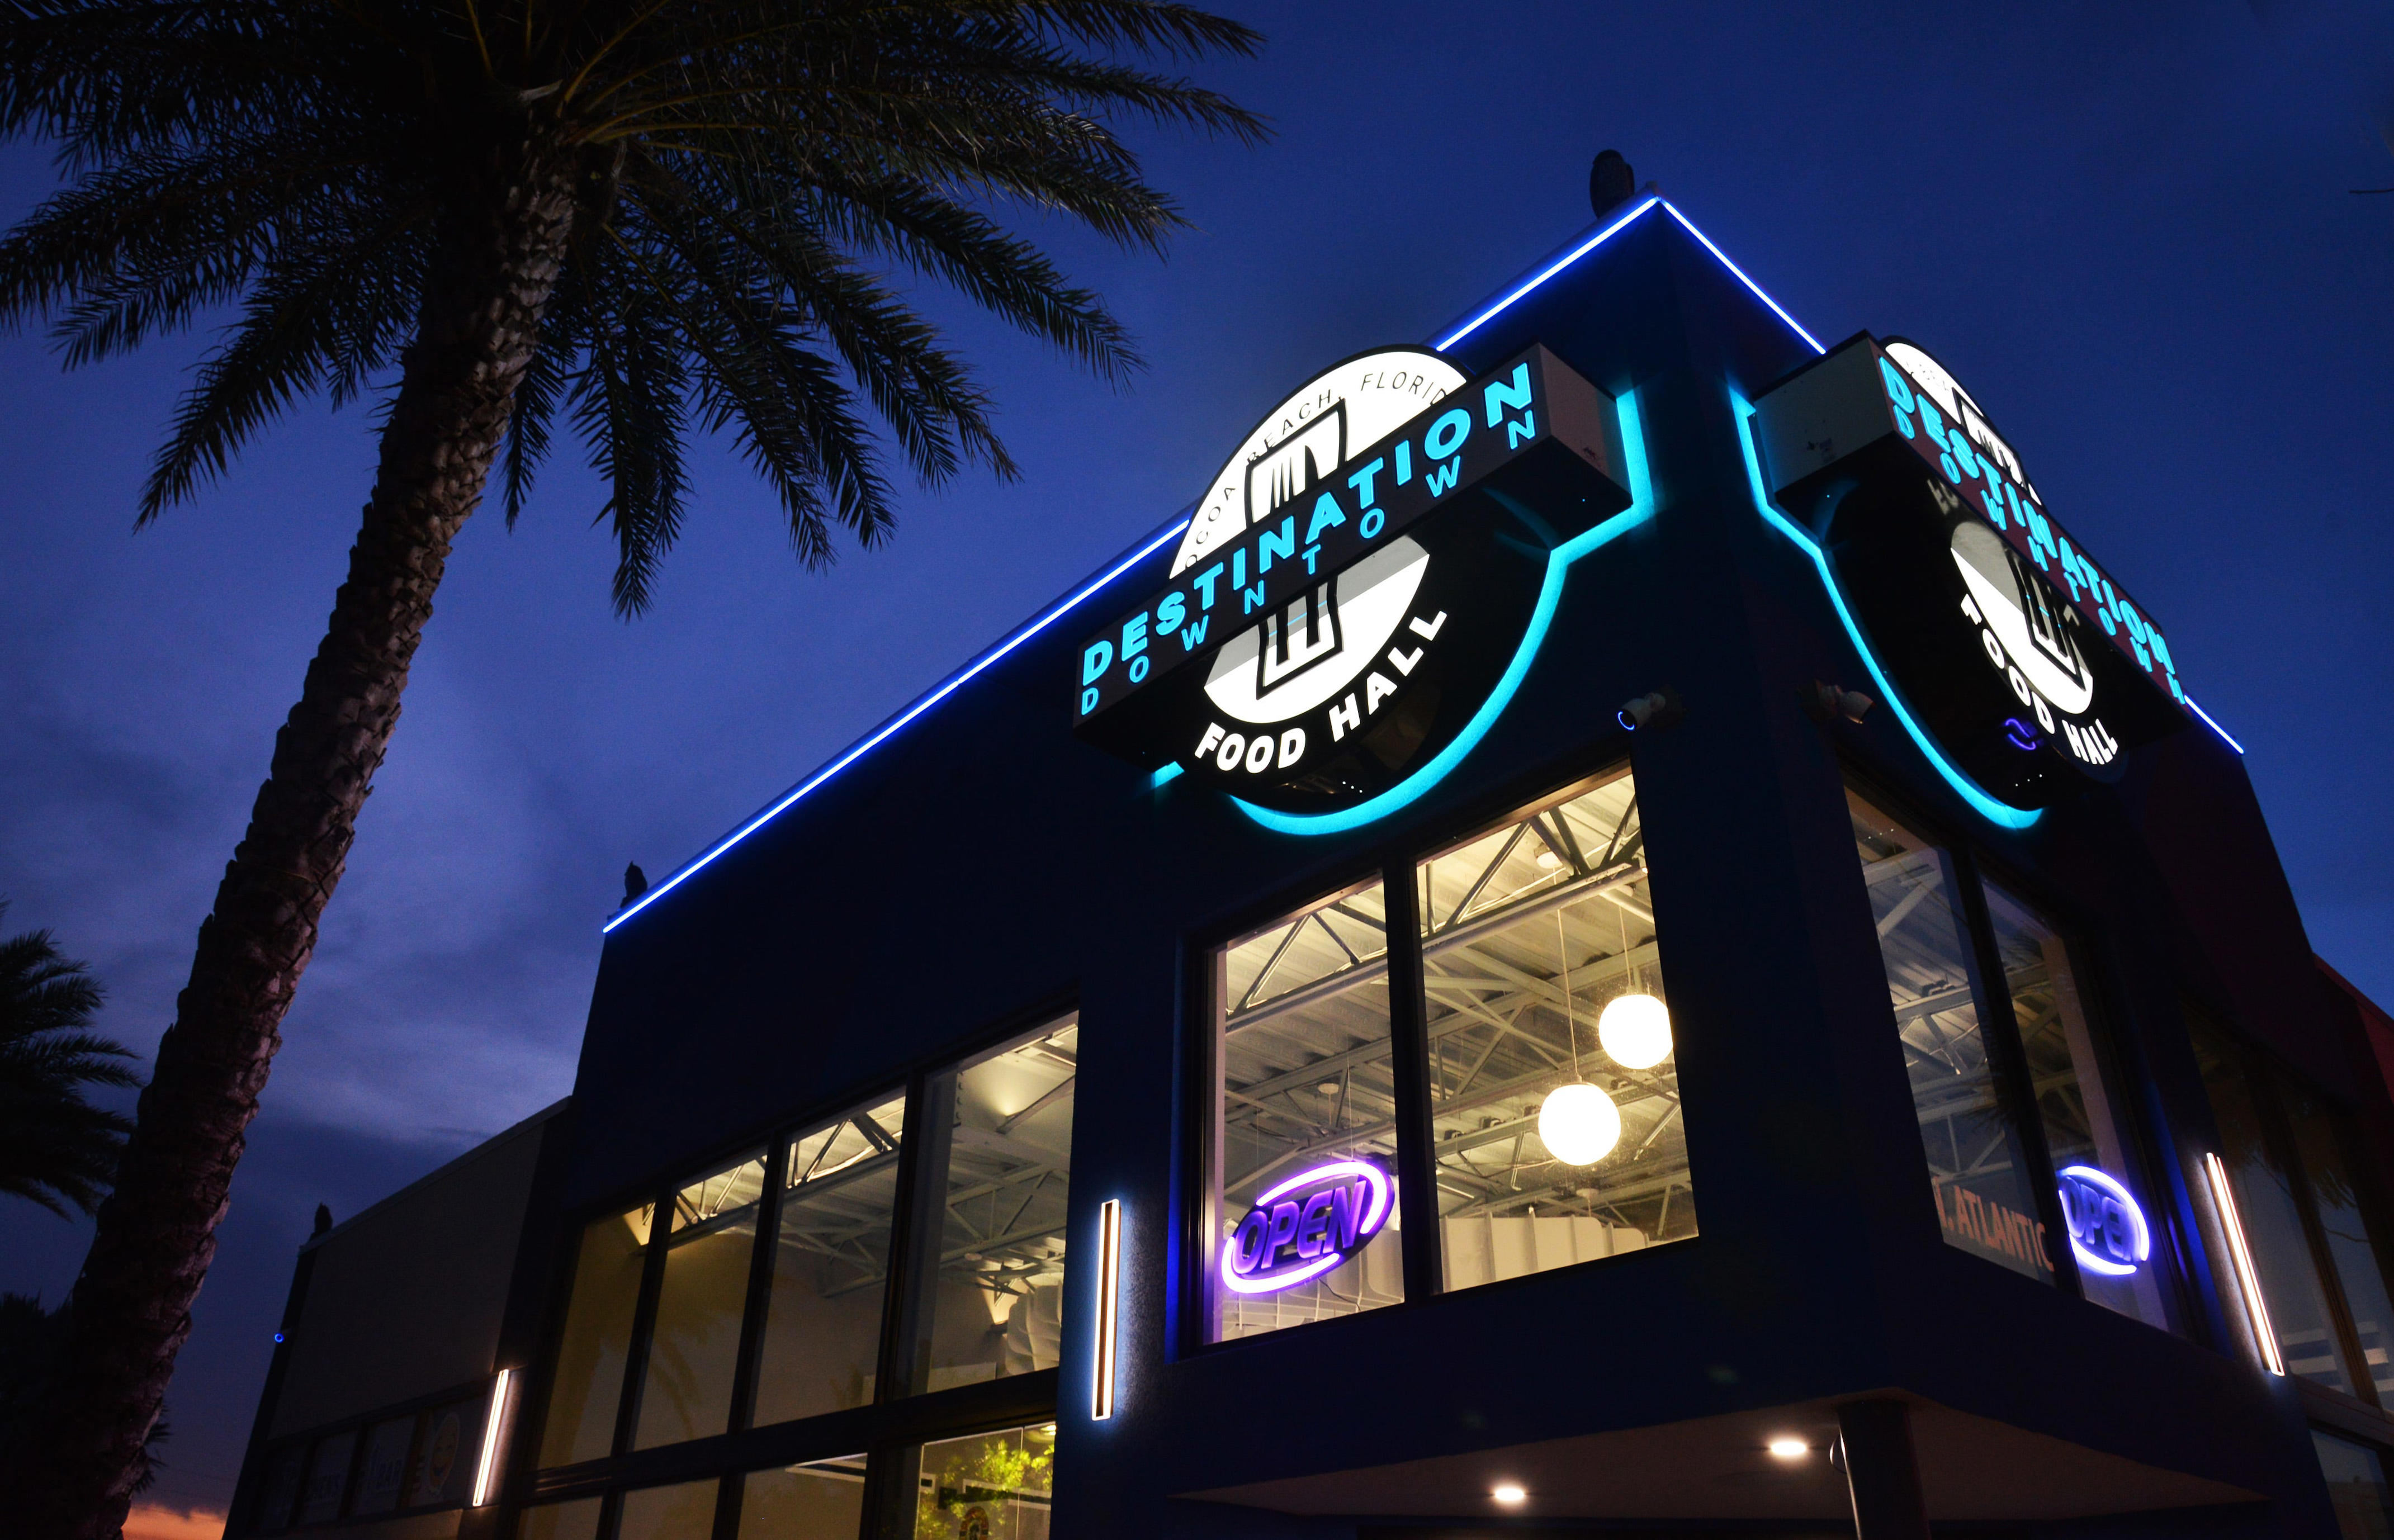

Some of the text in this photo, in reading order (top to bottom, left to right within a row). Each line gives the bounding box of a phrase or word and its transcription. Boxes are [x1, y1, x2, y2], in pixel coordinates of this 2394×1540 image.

[1082, 362, 1532, 686] DESTINATION
[1185, 486, 1236, 568] OCOA
[1361, 371, 1448, 406] FLORID
[1879, 356, 2176, 675] DESTINATION
[1081, 410, 1536, 717] DOWNTOWN
[1194, 610, 1447, 774] FOOD HALL
[1960, 593, 2118, 765] FOOD HALL
[1232, 1180, 1366, 1274] OPEN
[1953, 1184, 2055, 1272] ATLANTIC
